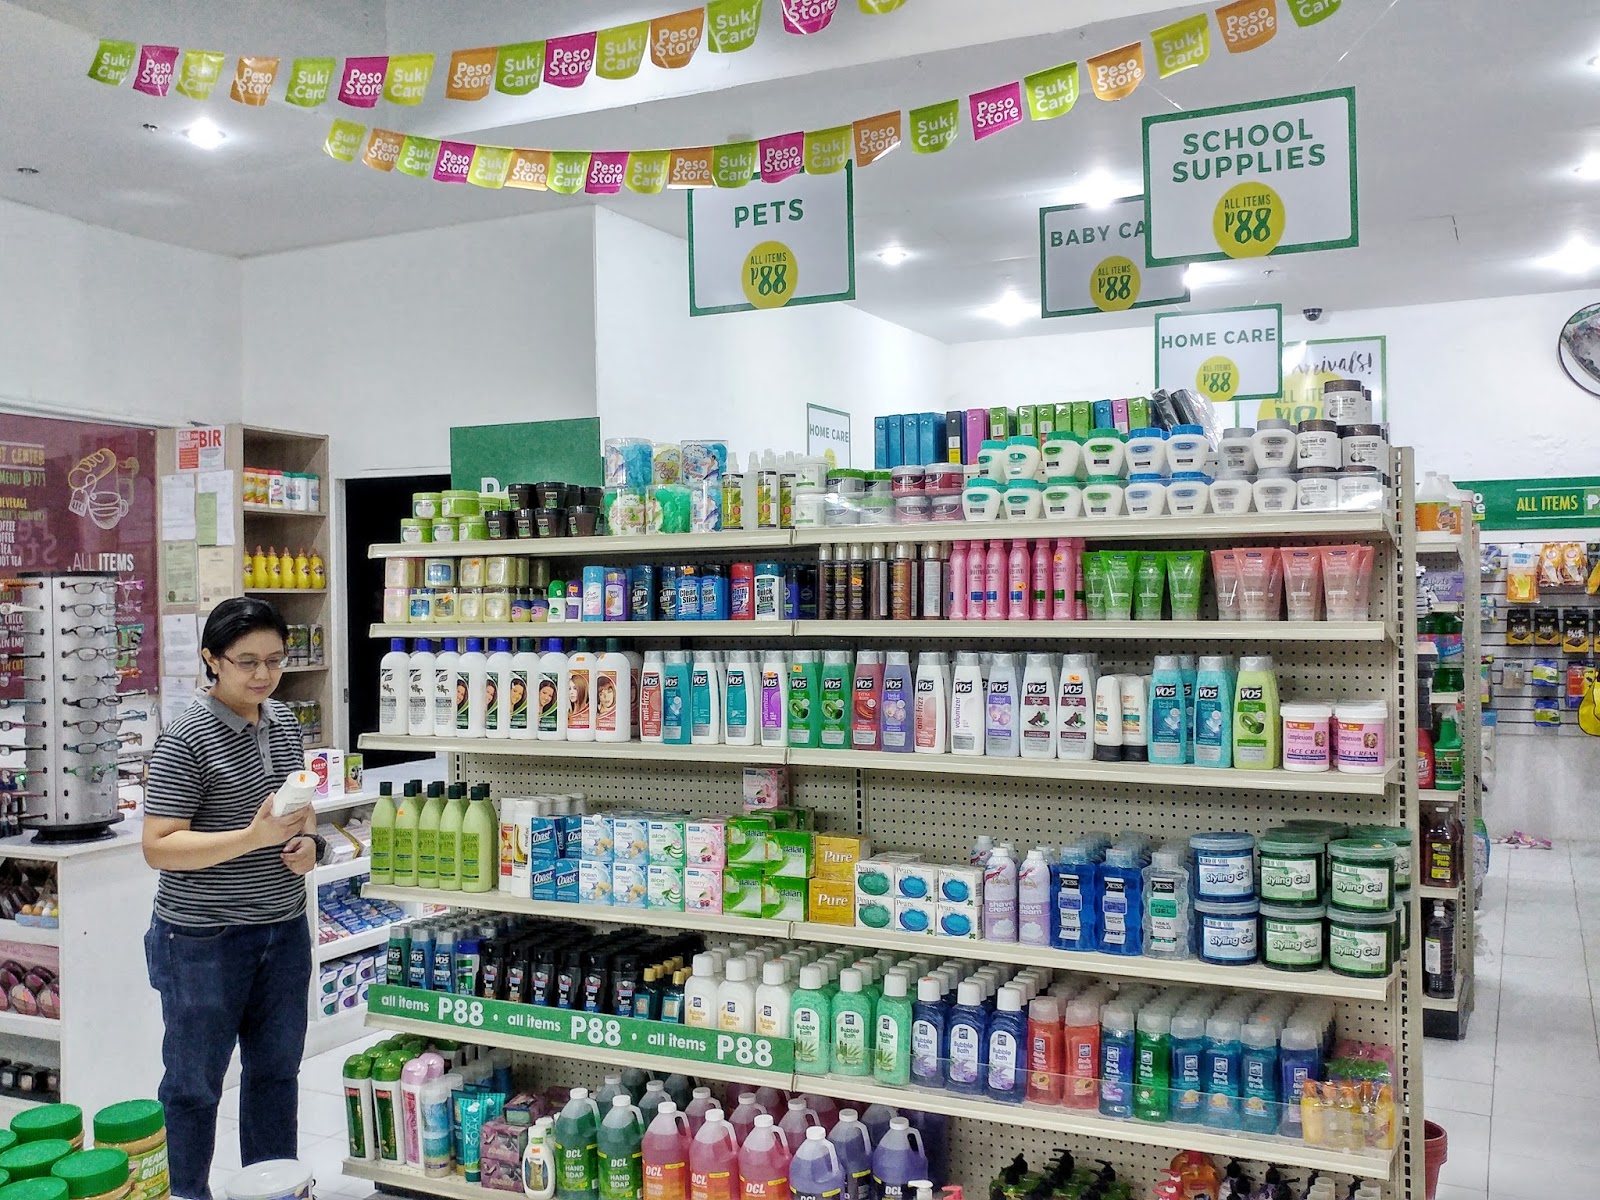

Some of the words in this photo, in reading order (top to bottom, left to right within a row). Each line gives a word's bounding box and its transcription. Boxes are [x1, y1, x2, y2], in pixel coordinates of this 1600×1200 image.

[716, 6, 758, 29] Suki
[788, 0, 836, 22] Store
[1226, 8, 1270, 29] Peso
[659, 27, 698, 45] Peso
[716, 26, 756, 46] Card
[1226, 16, 1275, 43] Store
[656, 36, 700, 57] Store
[1162, 31, 1202, 54] Suki
[101, 52, 131, 67] Suki
[505, 53, 542, 73] Suki
[553, 49, 590, 65] Peso
[1164, 47, 1205, 68] Card
[97, 66, 129, 81] Card
[146, 59, 172, 74] Peso
[458, 63, 492, 76] Peso
[550, 61, 592, 76] Store
[1097, 58, 1139, 81] Peso
[141, 70, 173, 85] Store
[242, 69, 273, 84] Peso
[298, 69, 330, 84] Suki
[350, 69, 382, 84] Peso
[394, 68, 429, 83] Suki
[453, 74, 493, 89] Store
[503, 72, 540, 88] Card
[1096, 66, 1142, 92] Store
[238, 81, 272, 95] Store
[294, 84, 327, 99] Card
[345, 81, 383, 96] Store
[391, 81, 426, 96] Card
[1034, 80, 1075, 98] Suki
[978, 96, 1015, 115] Peso
[1036, 93, 1076, 111] Card
[918, 113, 955, 132] Suki
[977, 108, 1020, 128] Store
[861, 126, 896, 141] Peso
[918, 130, 955, 147] Card
[1183, 119, 1314, 155] SCHOOL
[374, 138, 400, 153] Peso
[408, 144, 435, 158] Suki
[860, 136, 899, 154] Store
[369, 148, 400, 162] Store
[444, 151, 470, 166] Peso
[719, 153, 752, 168] Suki
[766, 147, 799, 161] Peso
[404, 158, 432, 172] Card
[439, 159, 470, 174] Store
[518, 159, 546, 173] Peso
[556, 161, 586, 174] Suki
[594, 161, 623, 173] Peso
[635, 161, 666, 174] Suki
[676, 157, 708, 170] Peso
[764, 156, 802, 173] Store
[1172, 144, 1326, 183] SUPPLIES
[513, 170, 547, 182] Store
[554, 175, 584, 186] Card
[590, 172, 624, 184] Store
[632, 175, 664, 186] Card
[673, 170, 711, 181] Store
[719, 169, 751, 181] Card
[1225, 198, 1241, 209] ALL
[1244, 194, 1272, 207] ITEMS
[735, 199, 804, 228] PETS
[1050, 224, 1112, 248] BABY
[1119, 221, 1145, 238] CA
[751, 255, 763, 265] ALL
[765, 252, 788, 262] ITEMS
[1098, 267, 1109, 276] ALL
[1111, 264, 1131, 274] ITEMS
[1162, 332, 1217, 349] HOME
[1224, 328, 1277, 344] CARE
[200, 430, 223, 448] BIR
[809, 424, 831, 439] HOME
[832, 428, 850, 442] CARE
[1517, 497, 1538, 511] ALL
[1542, 495, 1579, 510] ITEMS
[73, 553, 96, 571] ALL
[99, 553, 135, 571] ITEMS
[693, 676, 708, 684] VO5
[764, 679, 779, 687] VO5
[792, 679, 807, 688] VO5
[857, 679, 873, 688] VO5
[918, 681, 934, 690] VO5
[956, 683, 972, 692] VO5
[991, 684, 1009, 692] VO5
[1064, 685, 1083, 693] VO5
[1156, 688, 1176, 696] VO5
[1241, 690, 1262, 698] VO5
[532, 831, 553, 842] Coast
[824, 851, 854, 864] Pure
[534, 872, 554, 883] Coast
[557, 874, 578, 886] Coast
[1266, 875, 1293, 886] Styling
[1294, 873, 1311, 884] Gel
[1337, 882, 1364, 893] Styling
[1365, 883, 1384, 892] Gel
[818, 894, 849, 907] Pure
[1211, 936, 1239, 946] Styling
[1241, 934, 1254, 943] Gel
[1273, 940, 1303, 950] Styling
[1304, 938, 1318, 948] Gel
[381, 996, 396, 1005] all
[399, 996, 430, 1012] items
[438, 997, 484, 1026] P88
[507, 1014, 524, 1026] all
[527, 1014, 562, 1031] items
[571, 1015, 622, 1046] P88
[648, 1033, 666, 1045] all
[669, 1033, 707, 1051] items
[717, 1035, 773, 1067] P88
[566, 1150, 583, 1158] DCL
[611, 1159, 628, 1167] DCL
[646, 1166, 663, 1177] DCL
[692, 1173, 708, 1185] DCL
[746, 1183, 766, 1193] DCL
[885, 1186, 903, 1195] DCL
